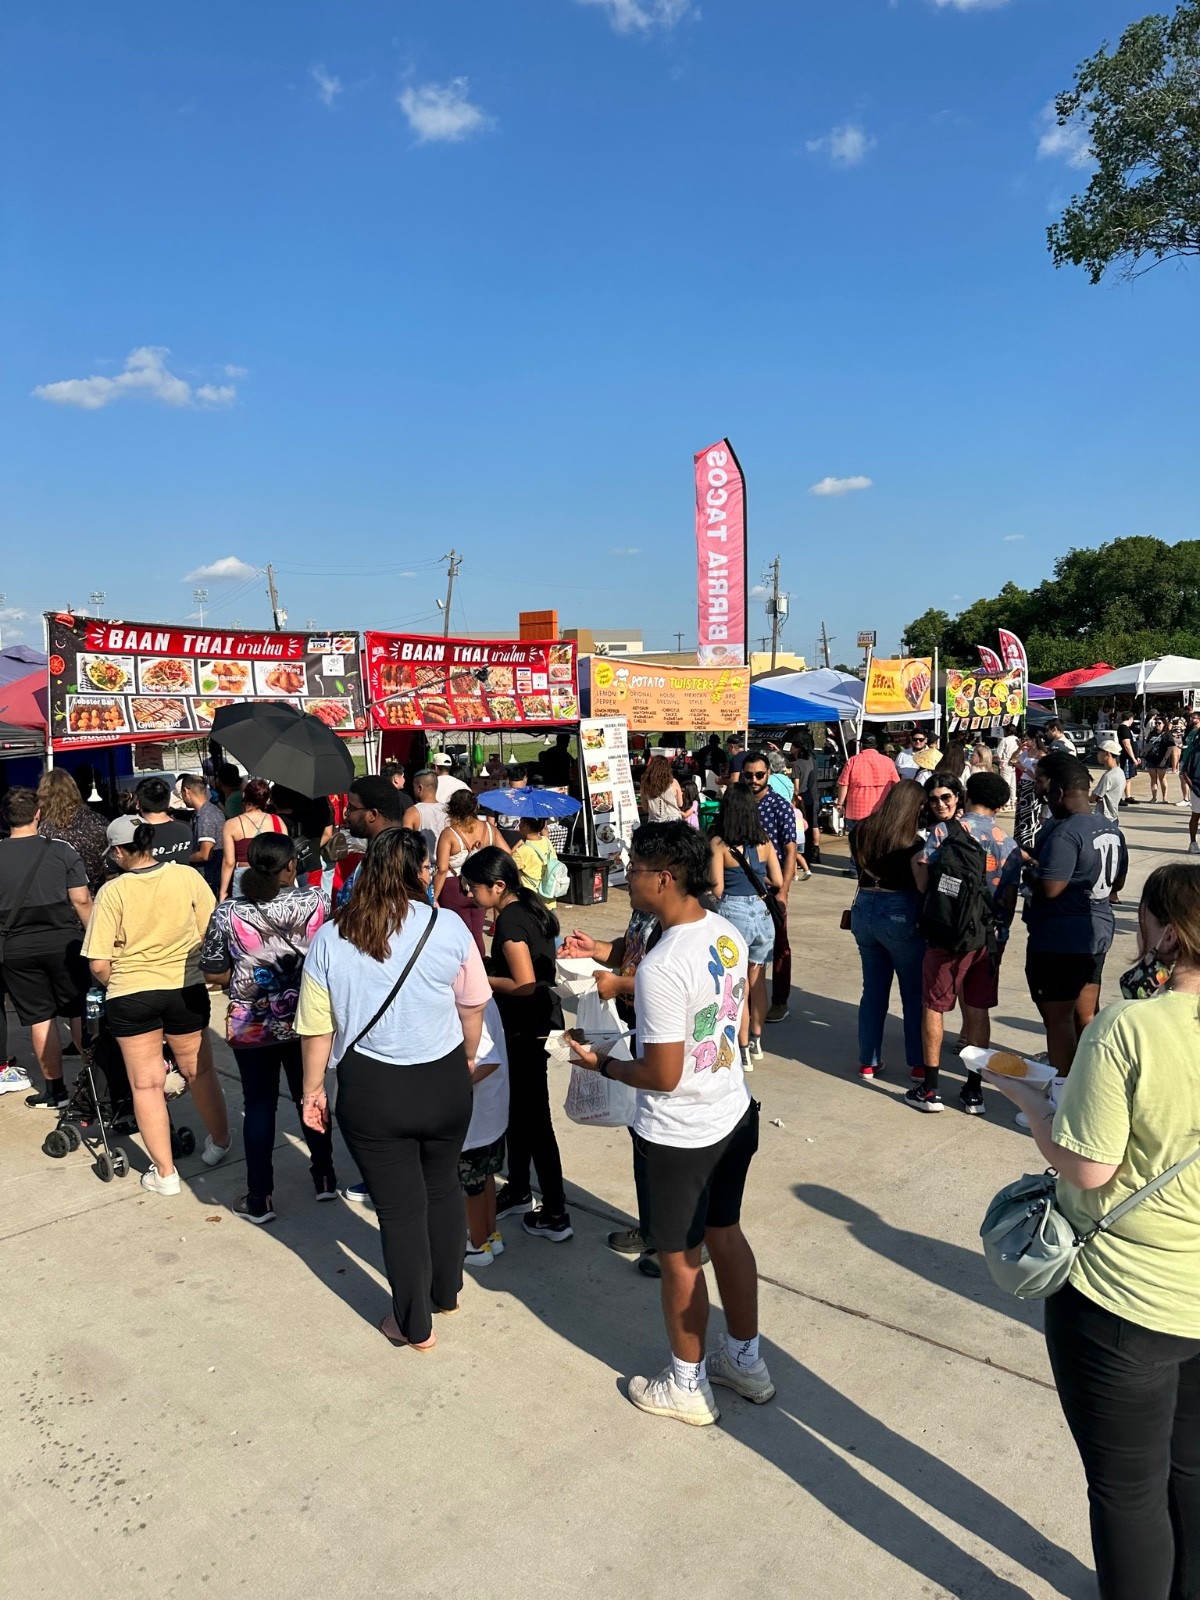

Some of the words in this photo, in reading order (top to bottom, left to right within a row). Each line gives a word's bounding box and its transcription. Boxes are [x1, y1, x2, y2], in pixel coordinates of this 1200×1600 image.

[108, 629, 171, 652] BAAN
[183, 634, 235, 655] THAI
[401, 643, 445, 662] BAAN
[453, 646, 491, 662] THAI
[629, 675, 666, 689] POTATO
[669, 677, 714, 690] TWISTERS
[583, 1080, 604, 1096] YOU
[587, 1096, 607, 1112] YOU
